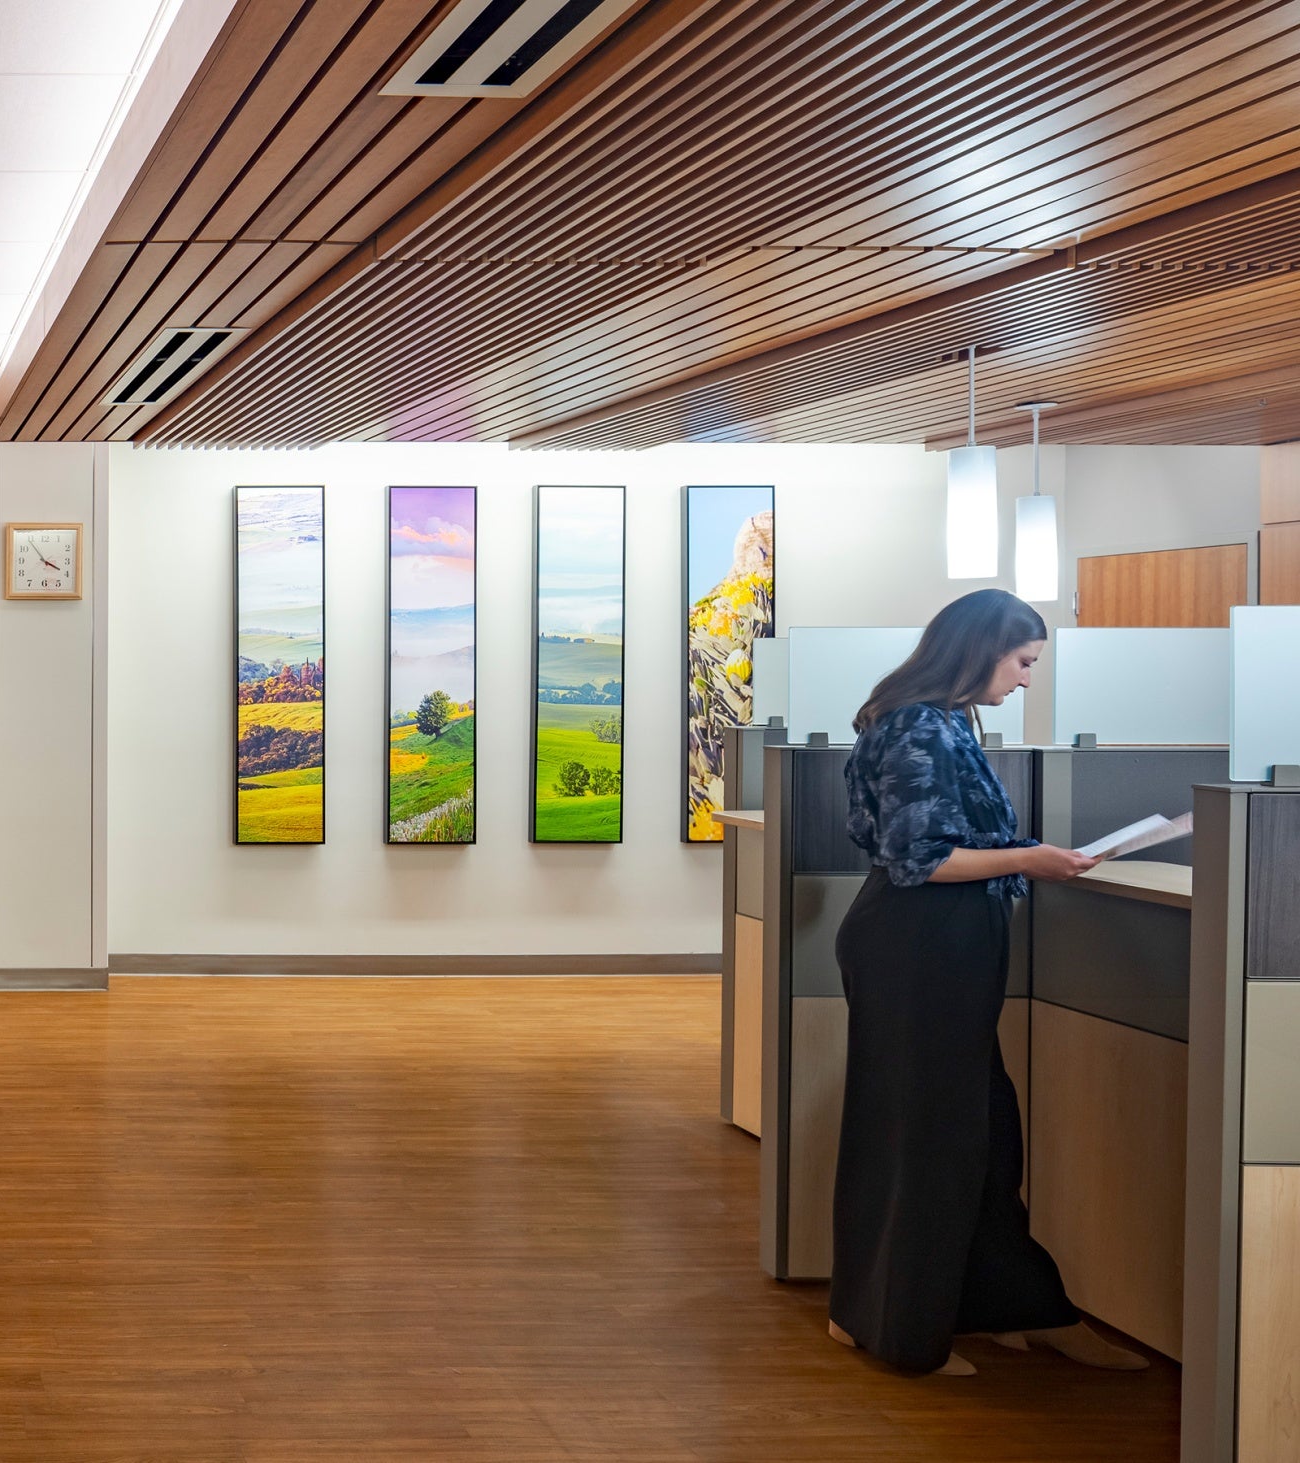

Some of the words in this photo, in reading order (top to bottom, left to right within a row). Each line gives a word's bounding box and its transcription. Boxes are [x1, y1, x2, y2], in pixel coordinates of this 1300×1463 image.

[20, 545, 29, 553] 10
[65, 544, 71, 552] 2
[18, 557, 25, 565] 9
[64, 557, 71, 566] 3
[18, 569, 25, 577] 8
[64, 570, 69, 578] 4
[27, 579, 33, 587] 7
[41, 579, 48, 587] 6
[55, 579, 61, 588] 5
